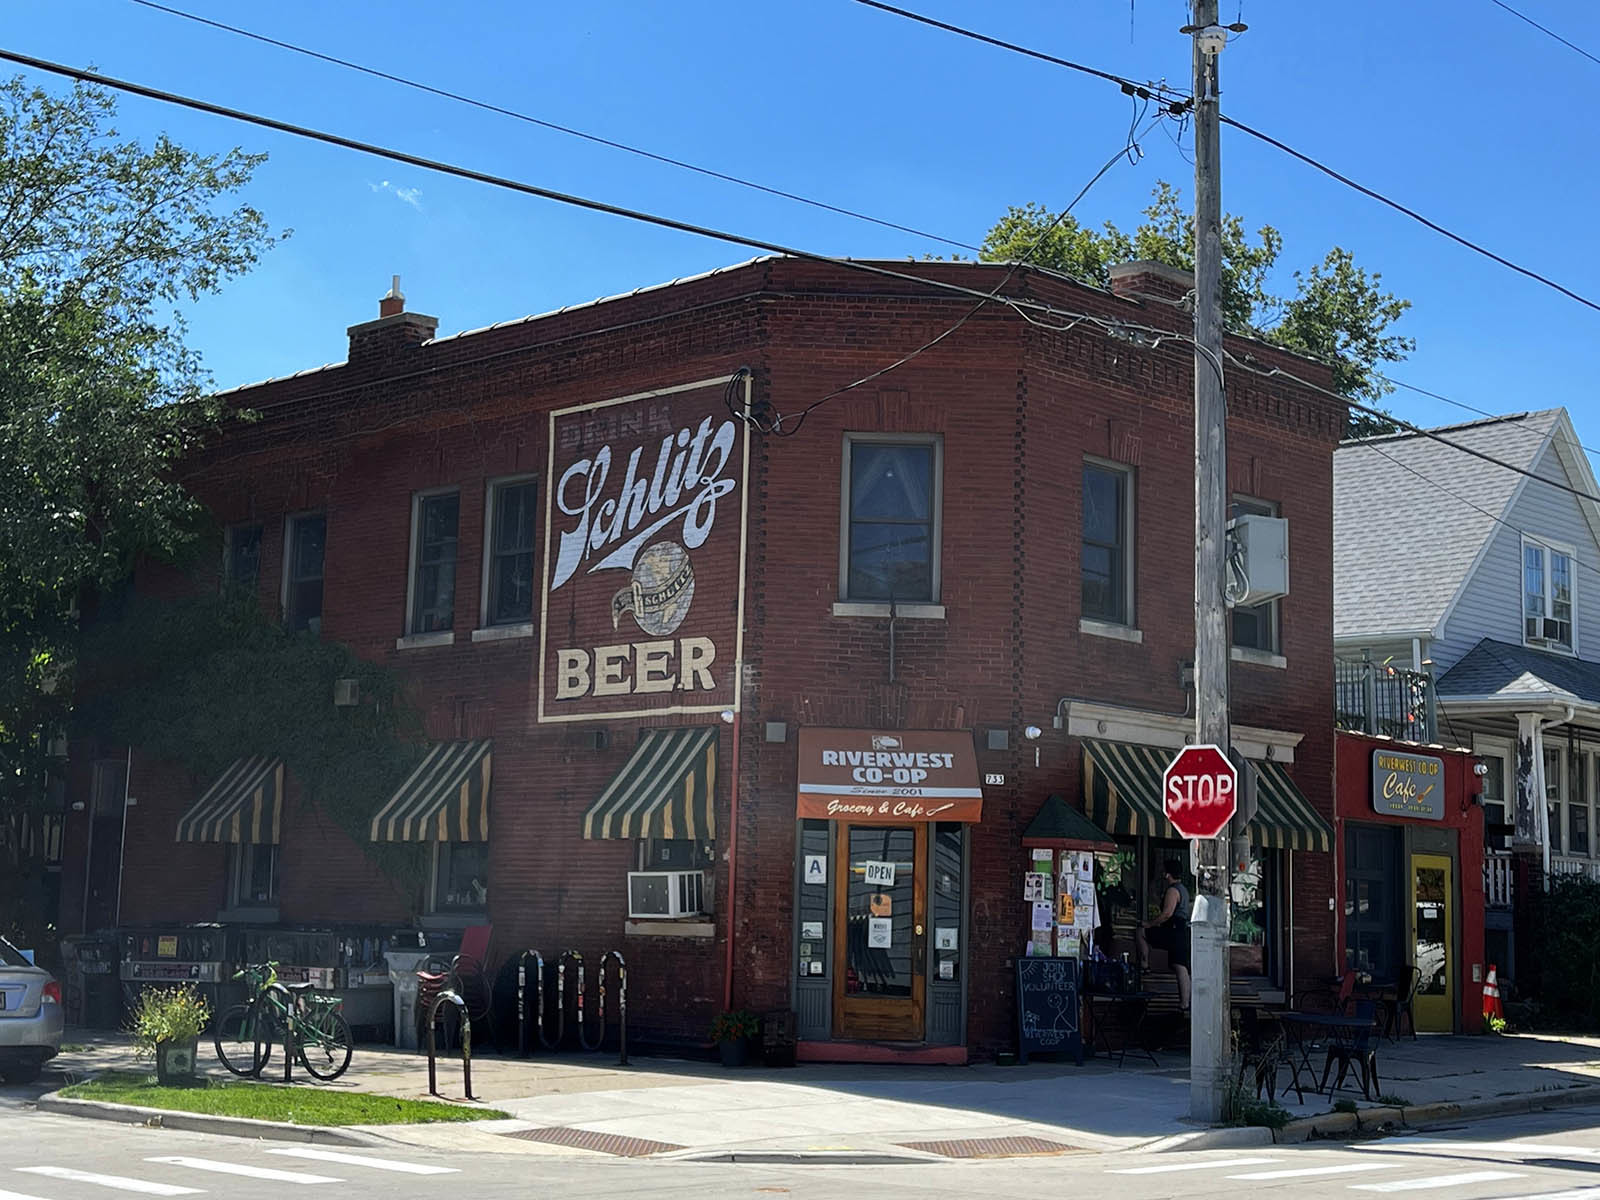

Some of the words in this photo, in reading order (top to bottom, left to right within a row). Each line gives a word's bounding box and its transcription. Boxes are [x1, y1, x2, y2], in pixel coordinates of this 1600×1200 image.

[551, 415, 736, 592] Schlitz
[555, 636, 717, 700] BEER
[822, 750, 955, 768] RIVERWEST
[852, 767, 928, 784] CO-OP
[986, 774, 1004, 784] 733
[892, 788, 922, 796] 2001
[1168, 773, 1233, 810] STOP
[1383, 771, 1417, 804] Cafe
[827, 799, 875, 816] Grocery
[877, 801, 889, 814] &
[892, 801, 924, 816] Cafe
[809, 859, 822, 874] A
[867, 864, 893, 881] OPEN
[1042, 962, 1065, 972] JOIN
